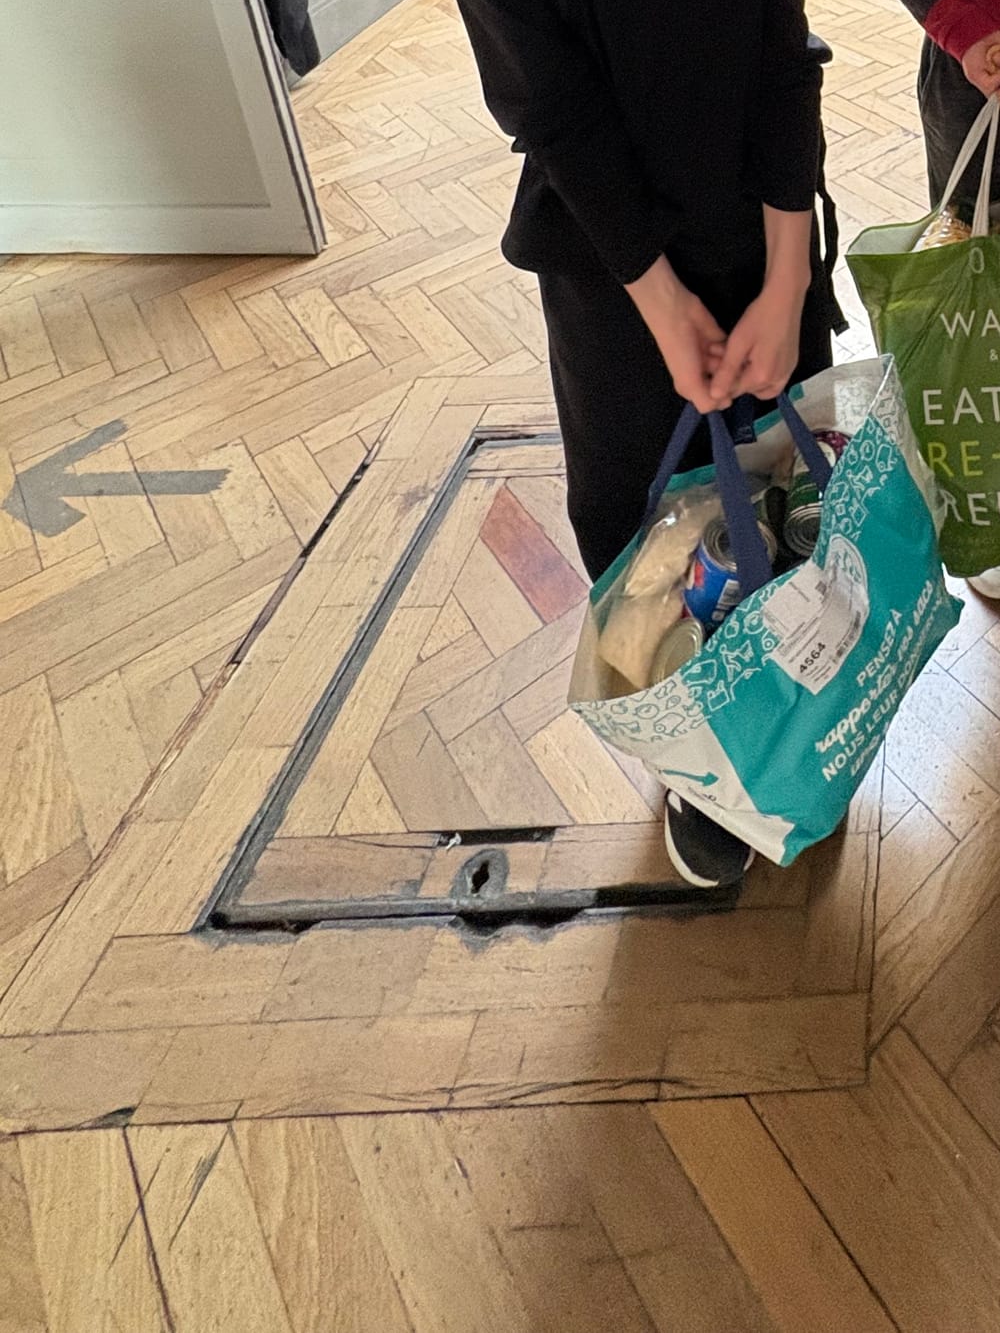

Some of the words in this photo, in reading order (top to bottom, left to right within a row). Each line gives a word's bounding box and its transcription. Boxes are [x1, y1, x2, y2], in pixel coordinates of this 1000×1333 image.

[989, 349, 999, 361] &
[799, 641, 827, 674] 4564
[856, 621, 896, 687] PENSEZ
[822, 730, 866, 782] NOUS
[865, 689, 898, 733] LEUR
